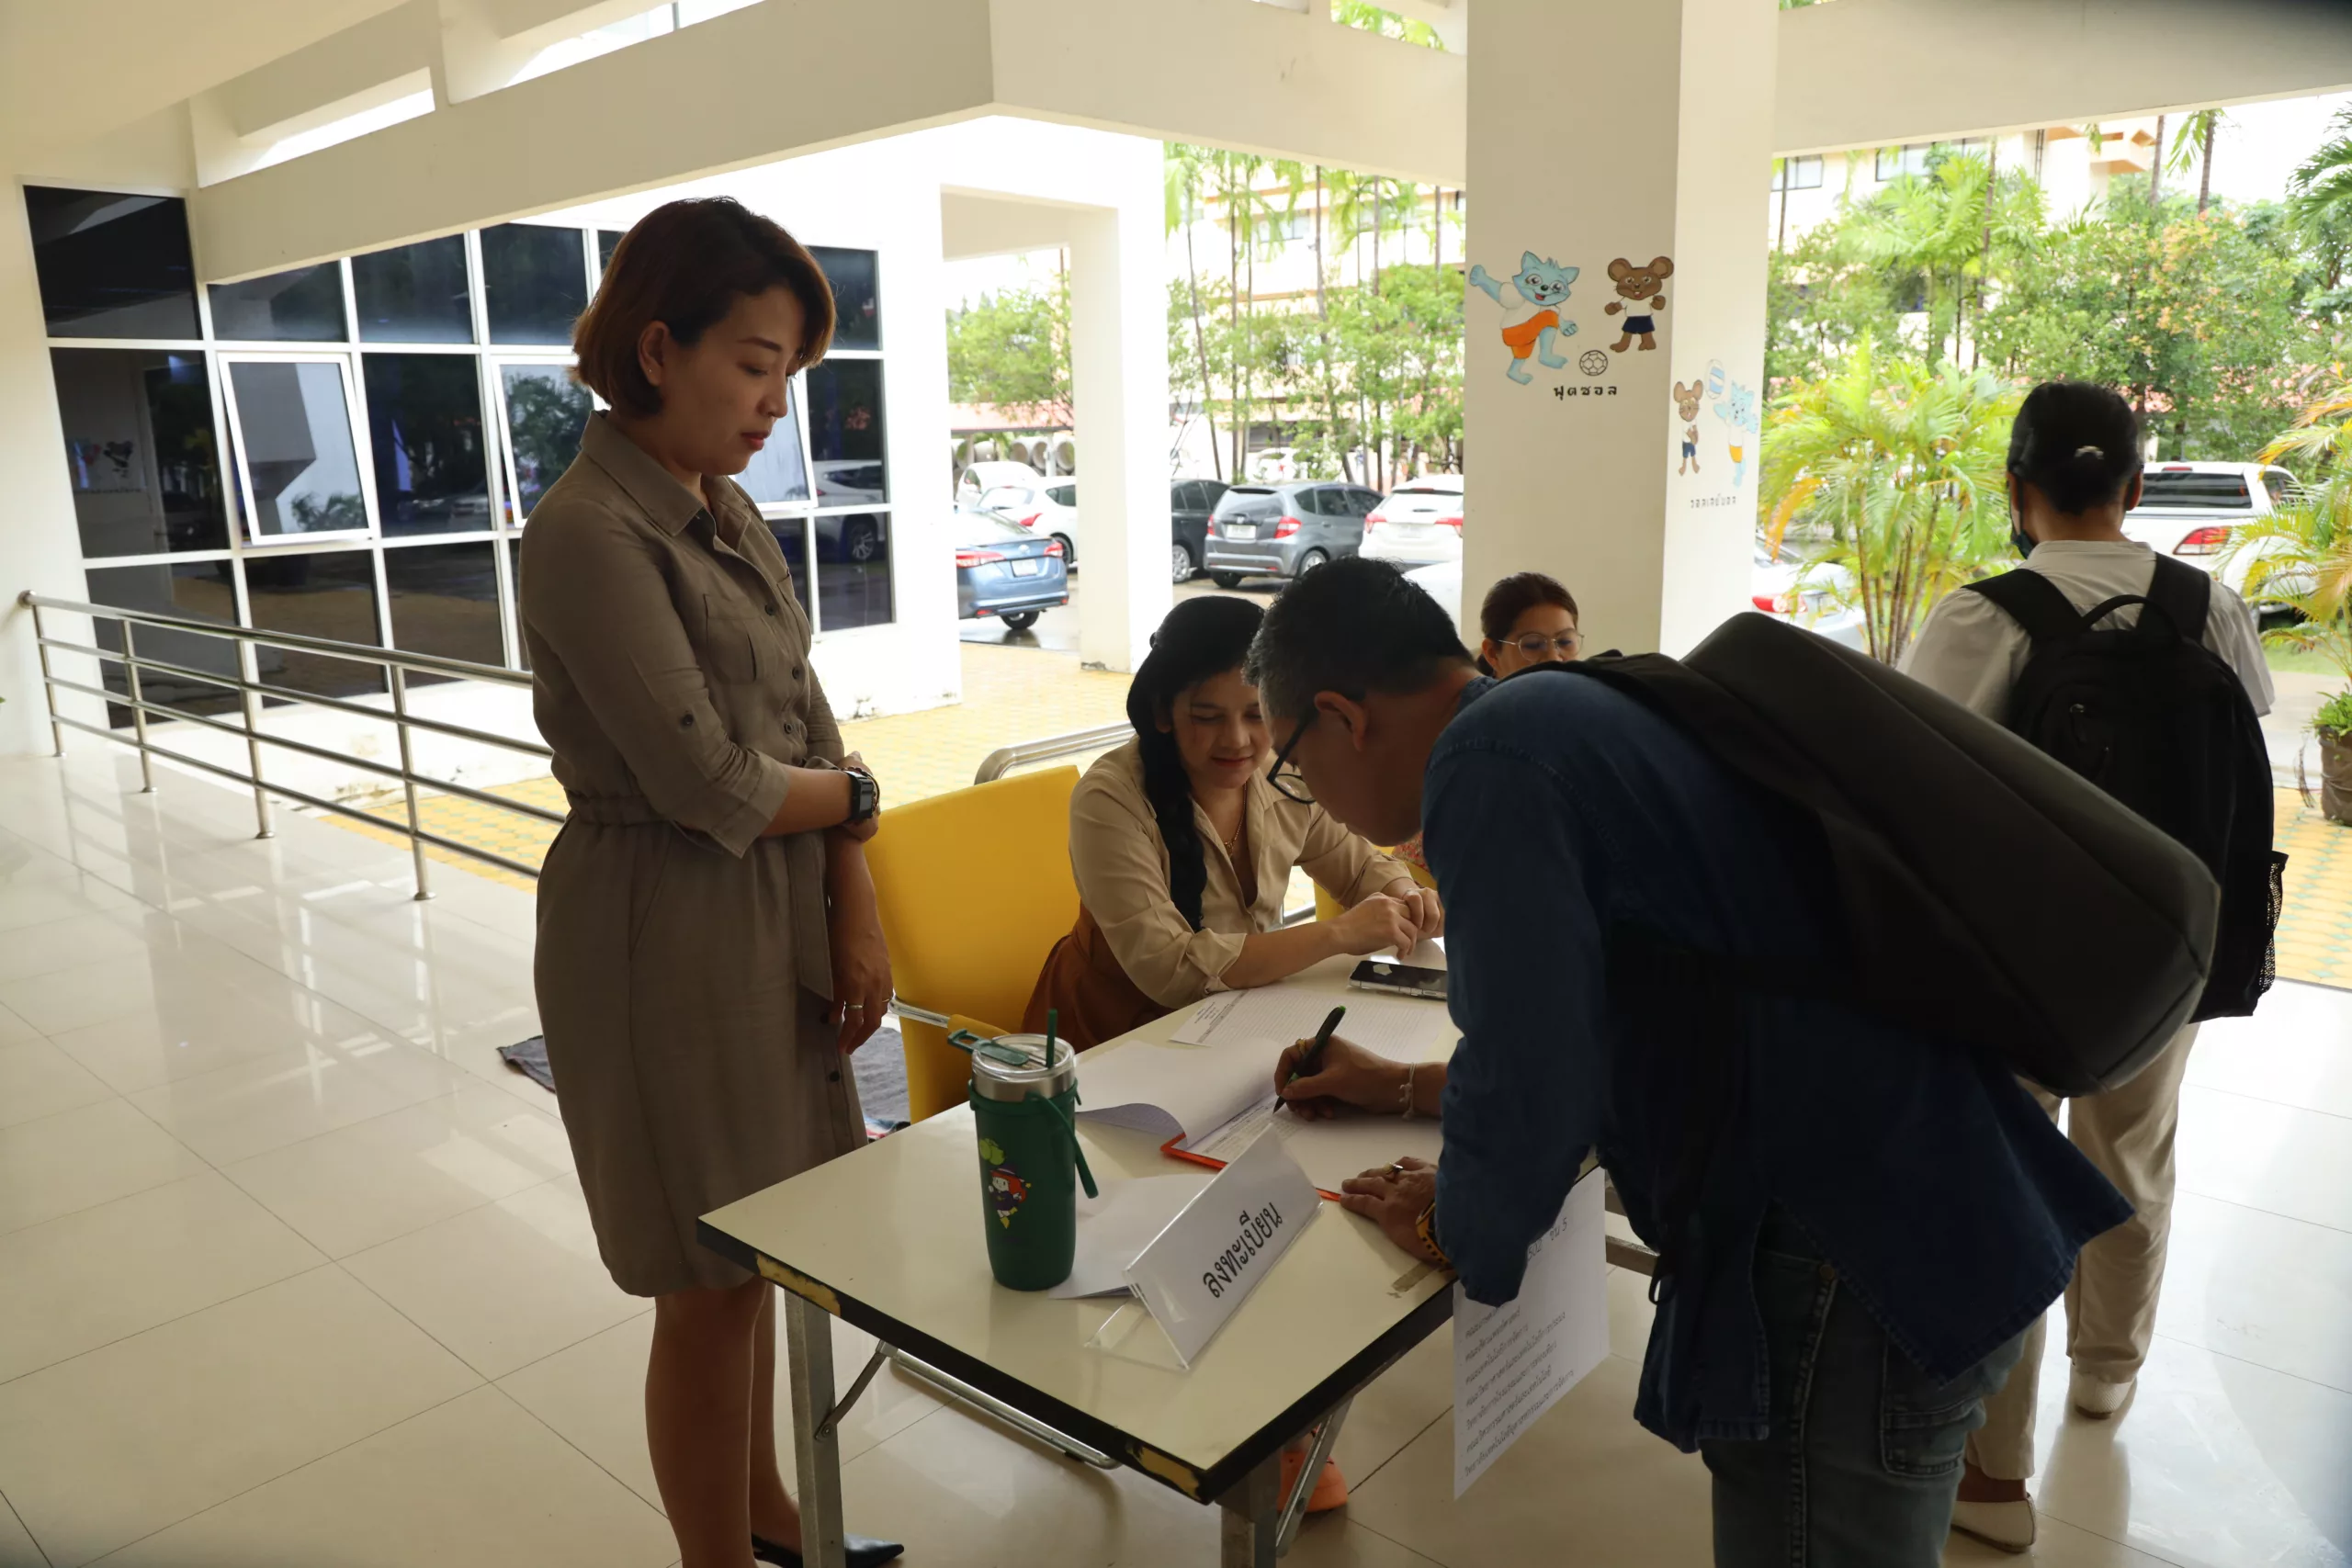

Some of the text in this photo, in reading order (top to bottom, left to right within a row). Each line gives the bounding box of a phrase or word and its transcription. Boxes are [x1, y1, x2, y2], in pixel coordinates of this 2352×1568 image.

[1553, 384, 1618, 401] ฟุตซอล
[1562, 1216, 1567, 1232] 5
[1203, 1201, 1283, 1299] ลงทะเบียน
